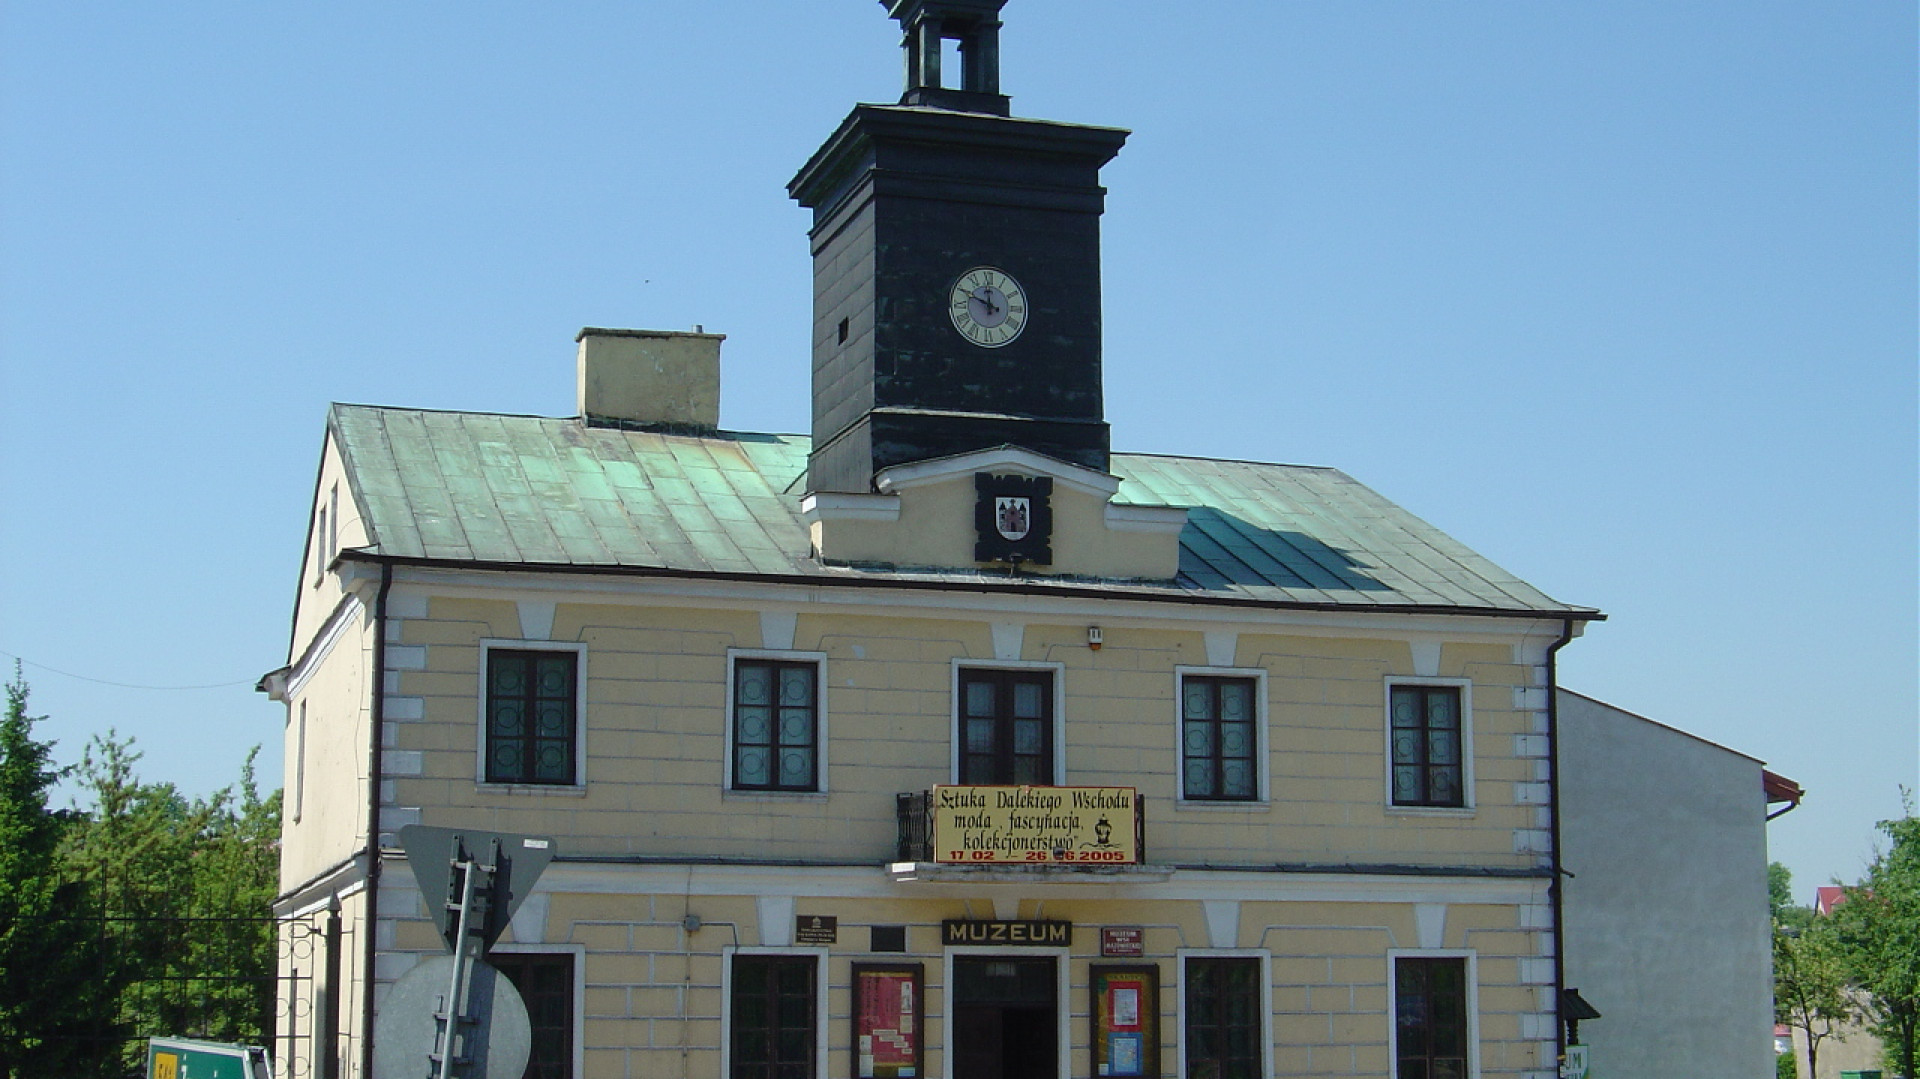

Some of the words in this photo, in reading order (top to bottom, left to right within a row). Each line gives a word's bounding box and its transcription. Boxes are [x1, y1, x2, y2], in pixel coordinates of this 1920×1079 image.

[996, 787, 1062, 816] Dalekiego
[1072, 789, 1129, 809] Wschodu
[950, 923, 1066, 942] MUZEUM
